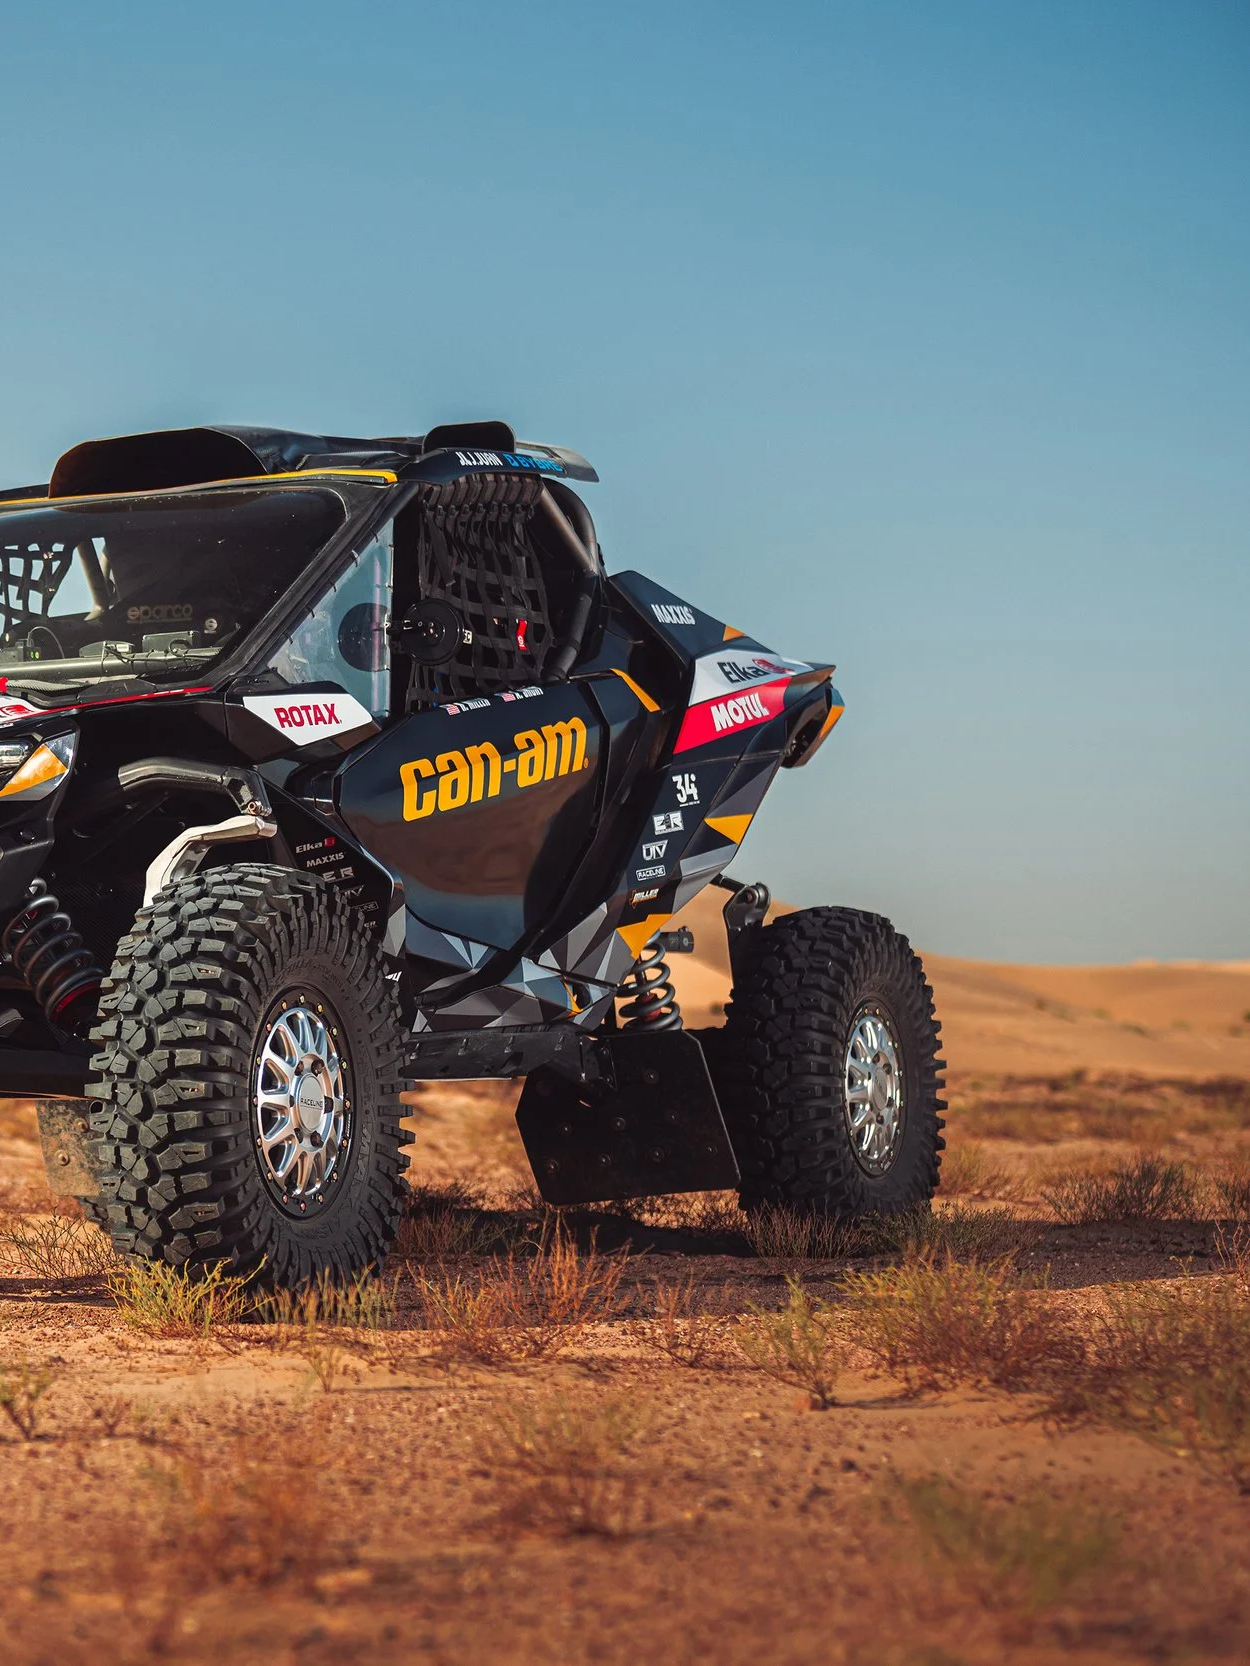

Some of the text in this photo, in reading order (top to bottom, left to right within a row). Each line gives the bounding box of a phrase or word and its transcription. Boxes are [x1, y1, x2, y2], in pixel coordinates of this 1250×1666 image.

[651, 603, 696, 625] MAXXIS
[716, 661, 771, 684] Elka
[274, 703, 340, 728] ROTAX
[709, 692, 770, 732] MOTUL
[399, 716, 588, 822] can-am
[295, 841, 323, 853] Elka
[306, 852, 345, 867] MAXXIS
